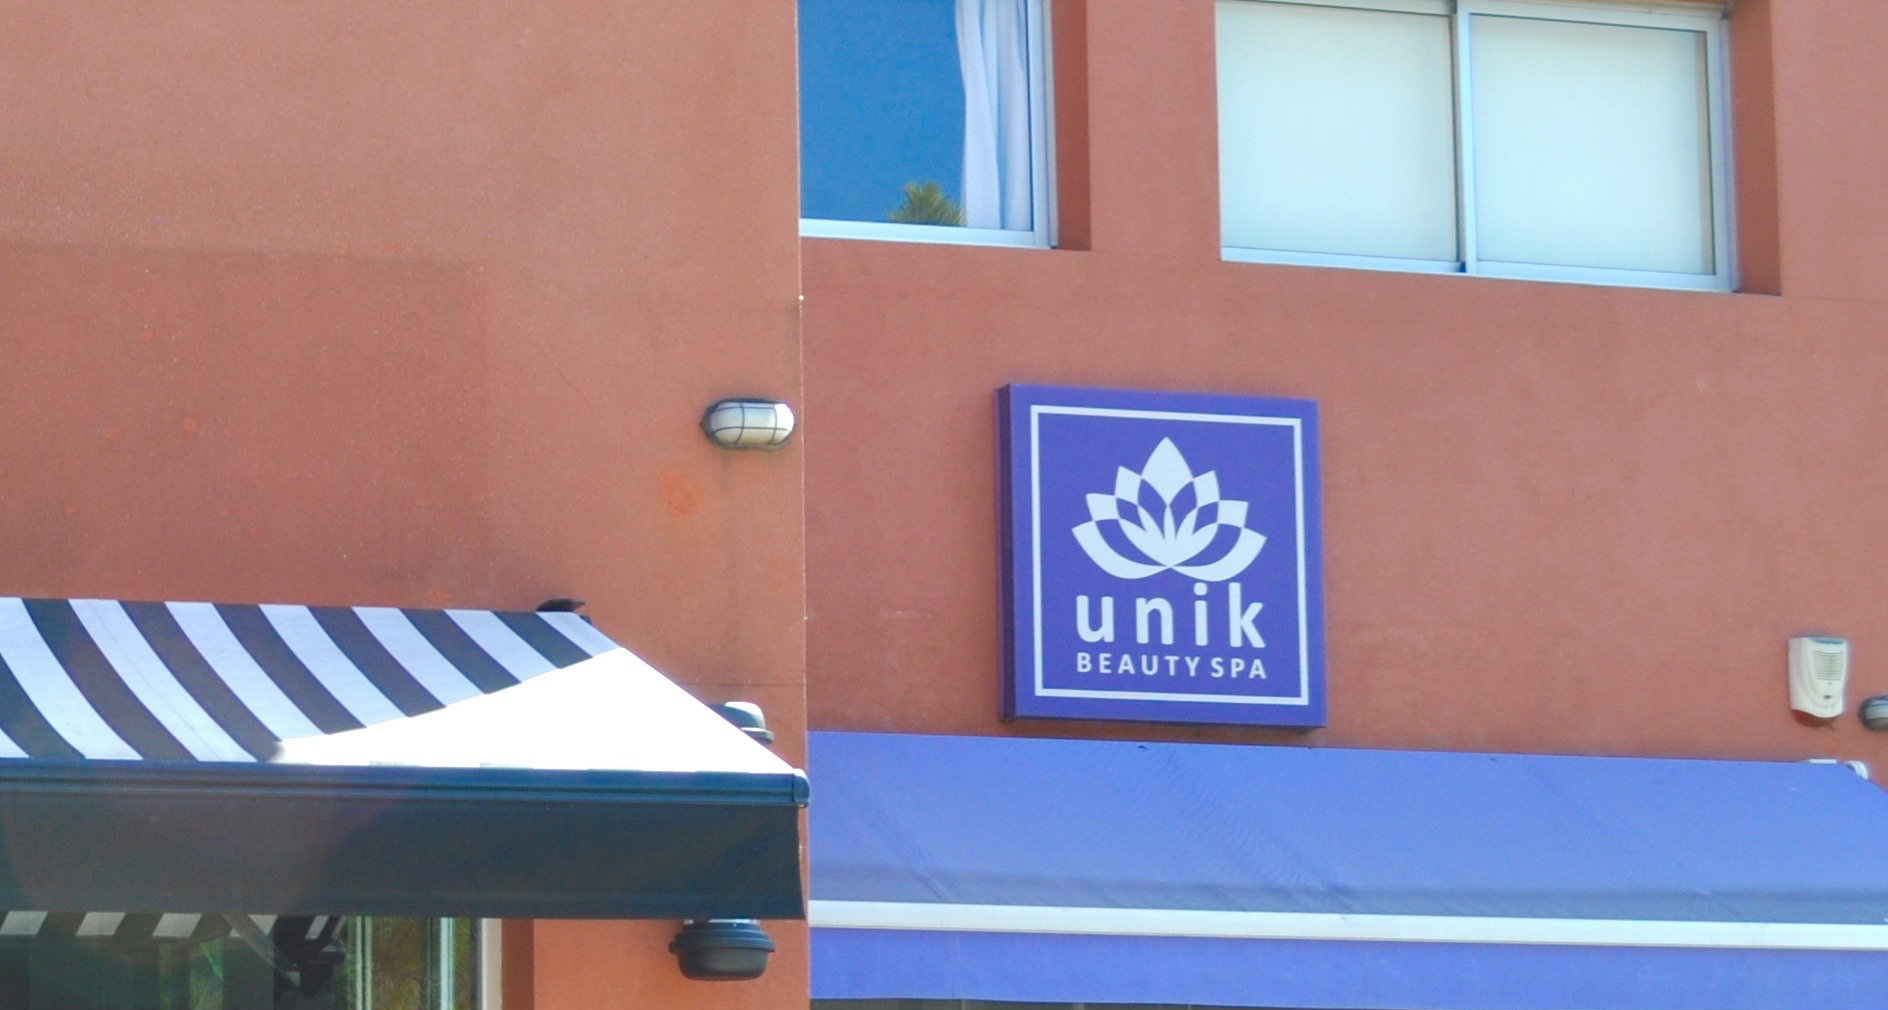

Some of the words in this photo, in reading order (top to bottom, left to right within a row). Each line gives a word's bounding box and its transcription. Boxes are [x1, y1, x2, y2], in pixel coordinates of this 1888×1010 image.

[1075, 581, 1267, 649] unik
[1076, 651, 1201, 677] BEAUTY
[1210, 656, 1267, 680] SPA
